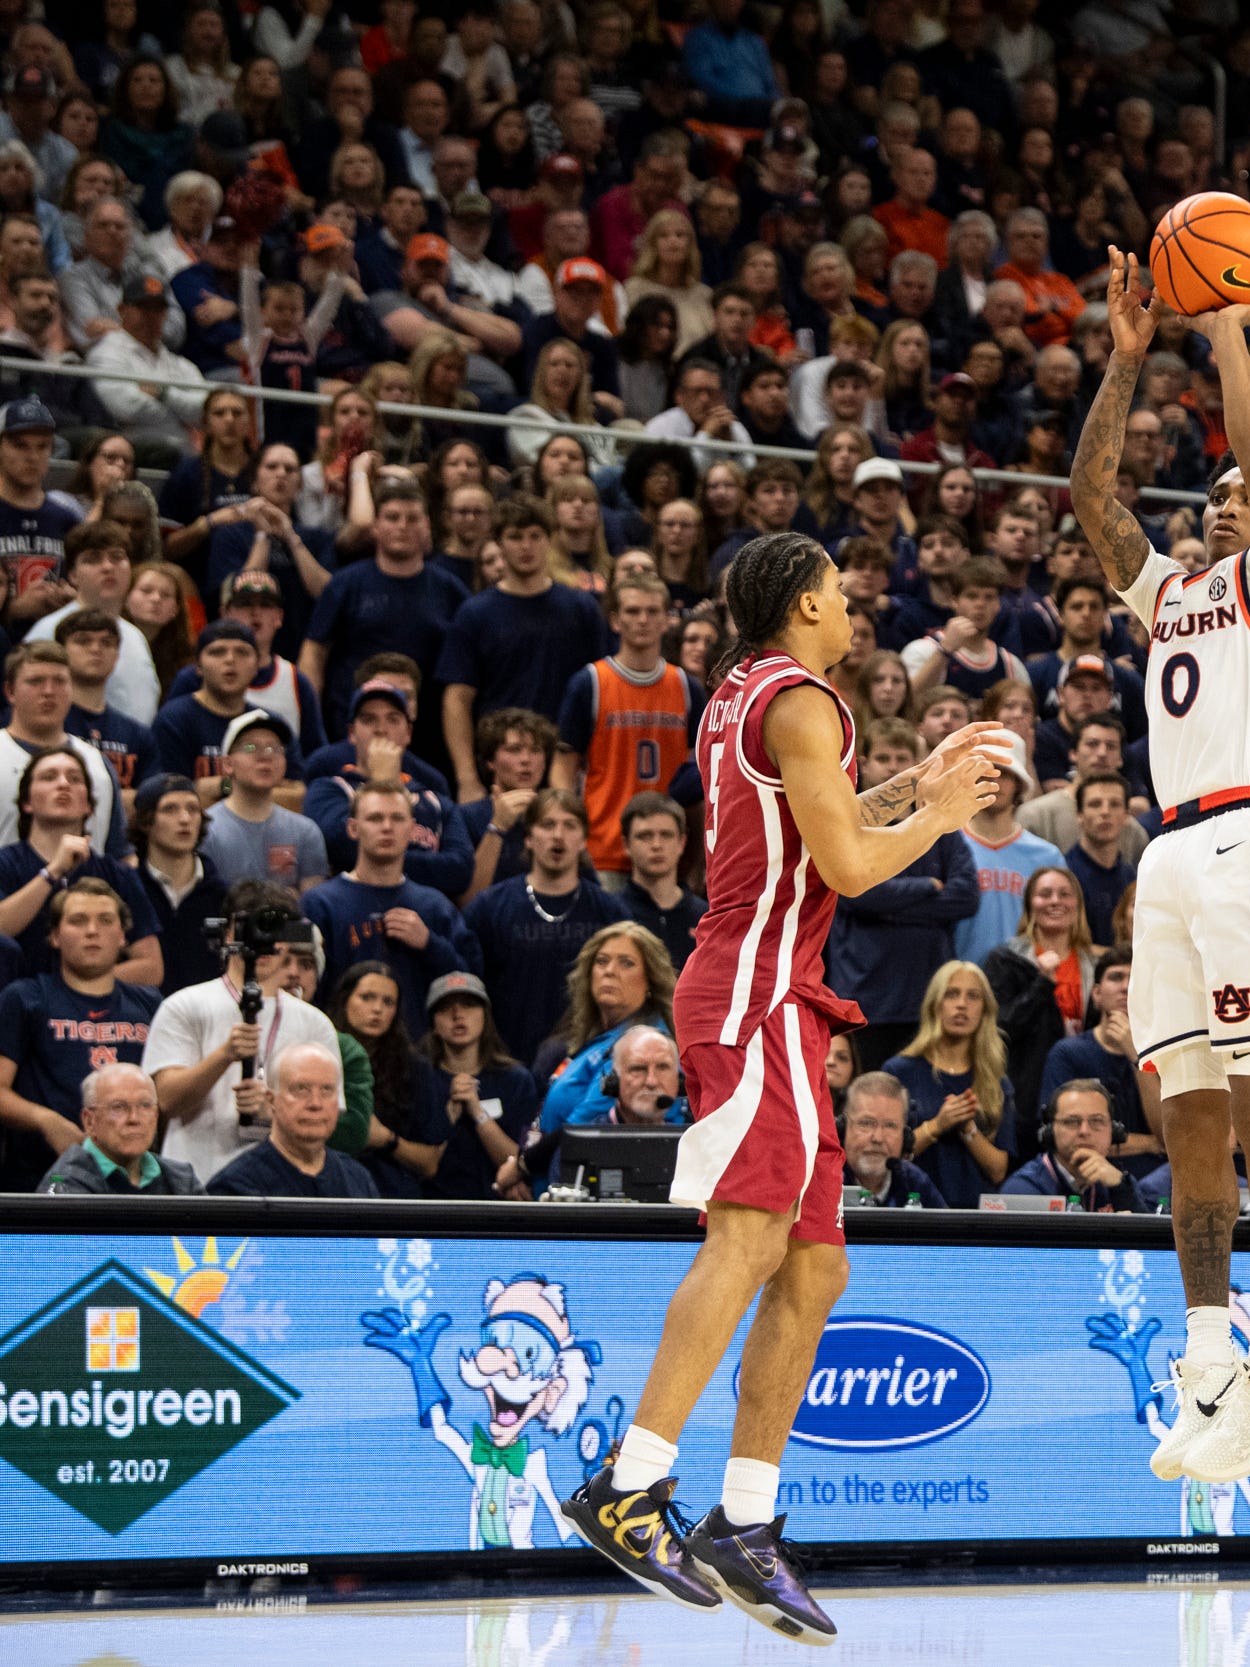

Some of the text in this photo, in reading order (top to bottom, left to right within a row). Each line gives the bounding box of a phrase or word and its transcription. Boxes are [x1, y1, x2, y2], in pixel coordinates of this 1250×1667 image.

[1161, 652, 1200, 718] 0
[637, 740, 660, 784] 0
[48, 1018, 150, 1043] TIGERS
[803, 1354, 957, 1407] arrier
[56, 1458, 170, 1484] est. 2007
[777, 1474, 989, 1511] rn to the experts
[1146, 1543, 1220, 1555] DAKTRONICS
[217, 1563, 309, 1576] DAKTRONICS
